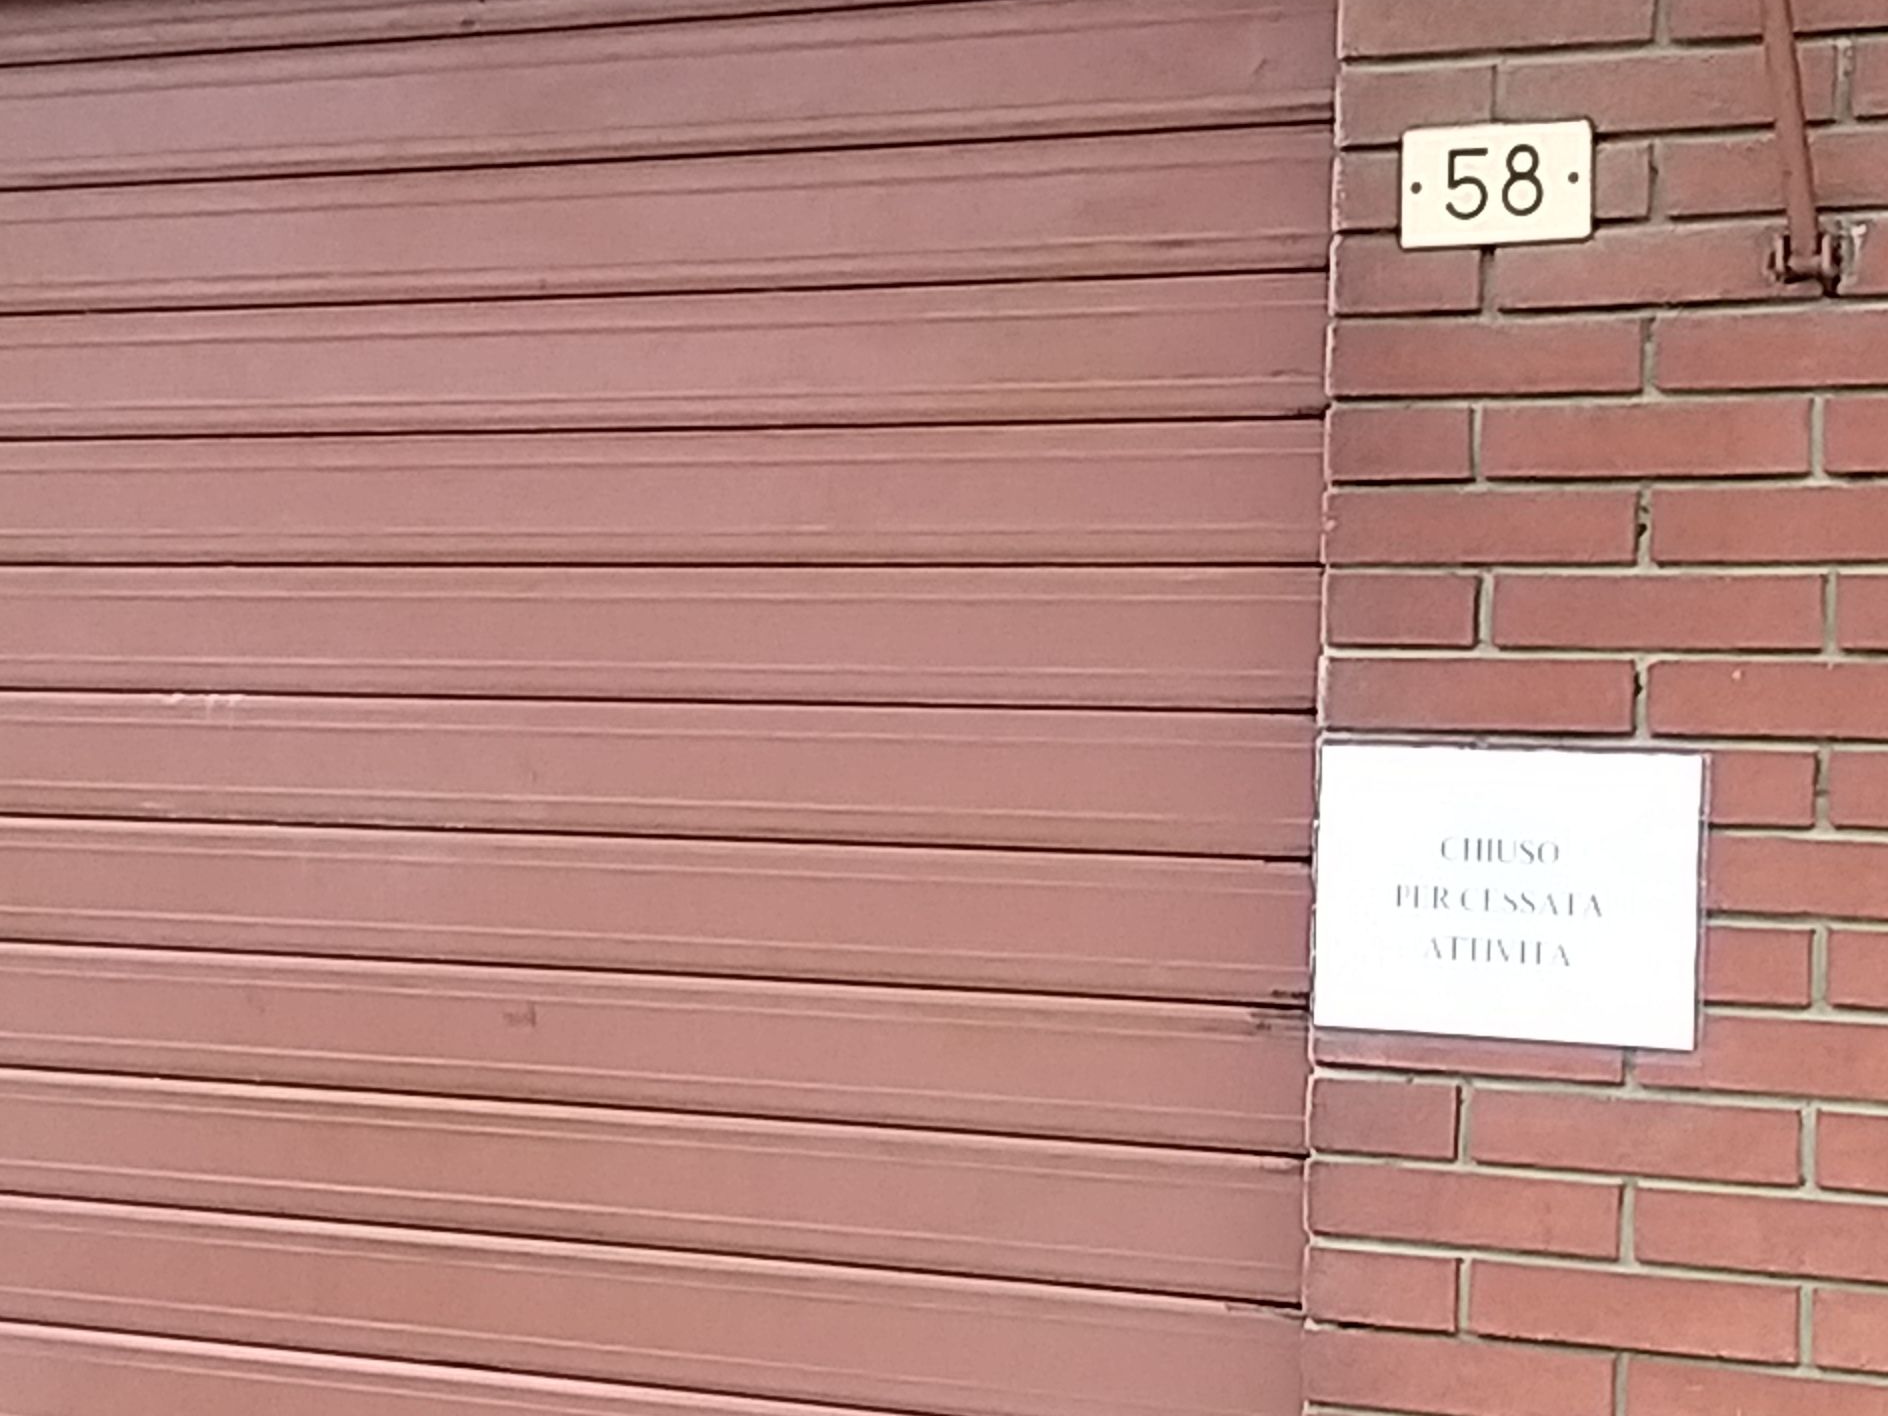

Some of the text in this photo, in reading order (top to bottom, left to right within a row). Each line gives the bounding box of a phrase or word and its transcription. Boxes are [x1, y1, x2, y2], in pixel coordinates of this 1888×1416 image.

[1445, 143, 1544, 220] 58
[1439, 836, 1561, 865] CHIUSO
[1395, 883, 1603, 919] PER CESSATA
